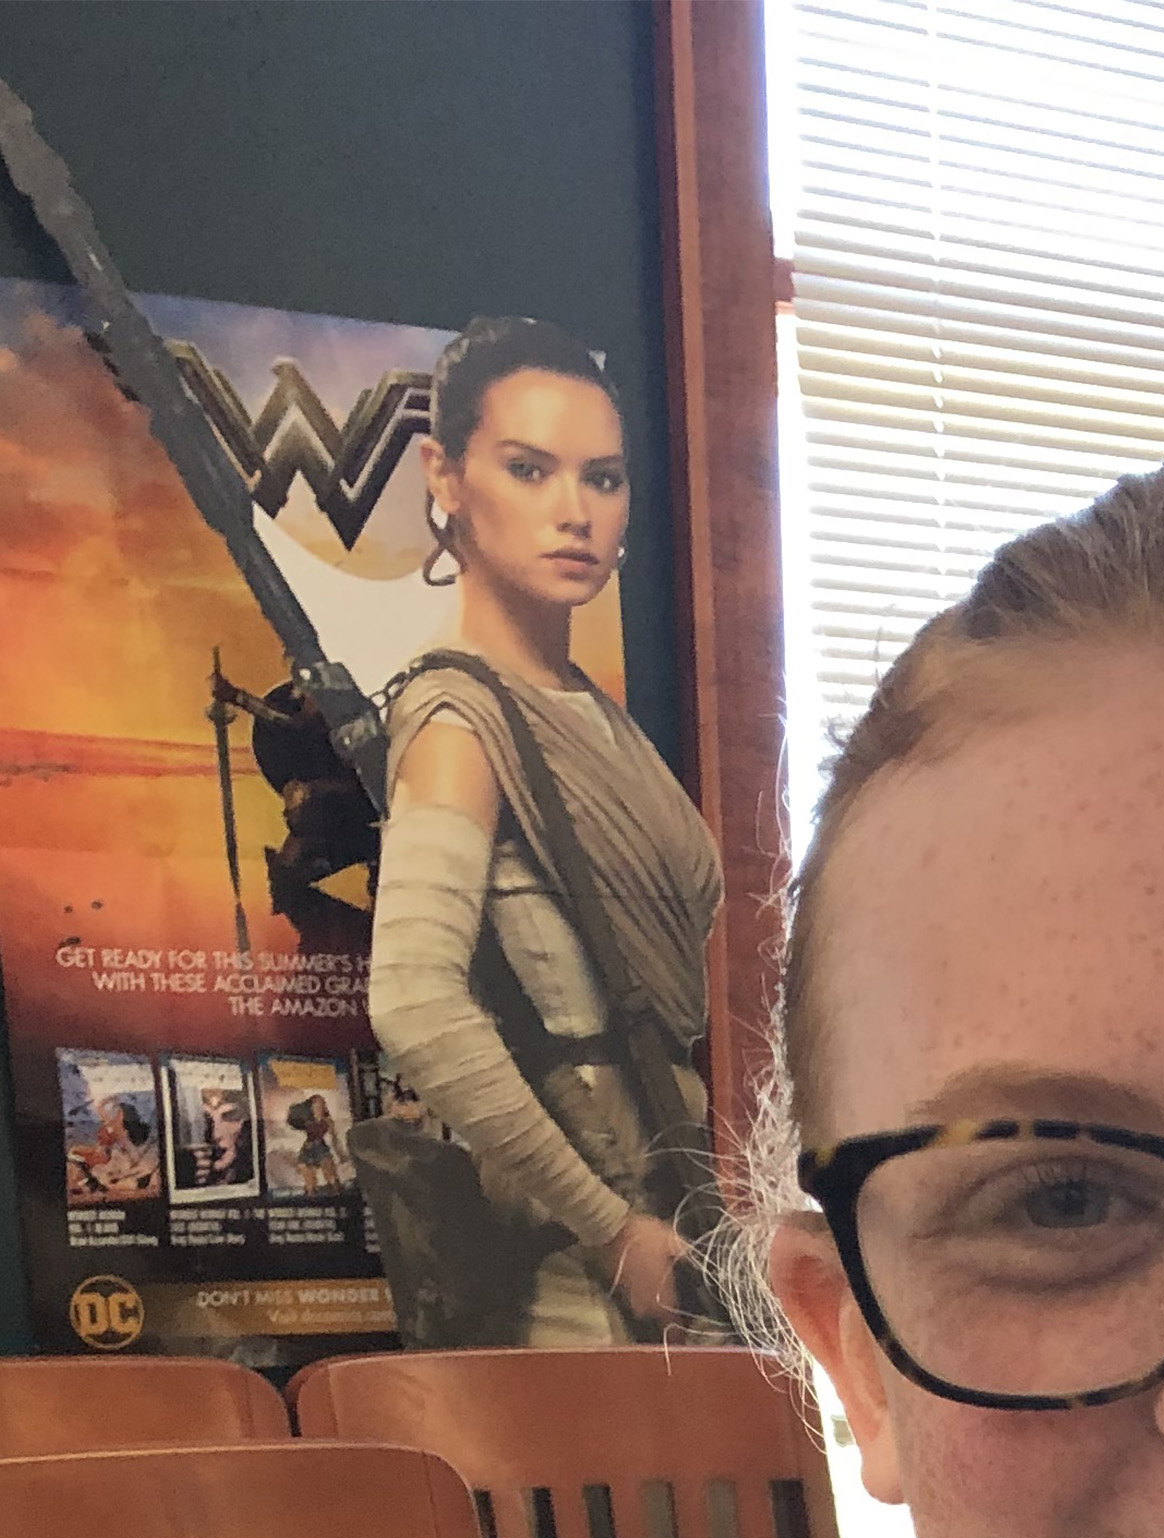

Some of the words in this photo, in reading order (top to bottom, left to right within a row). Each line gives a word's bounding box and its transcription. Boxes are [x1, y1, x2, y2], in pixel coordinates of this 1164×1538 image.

[56, 947, 96, 968] GET
[102, 949, 162, 970] READY
[168, 950, 206, 970] FOR
[213, 951, 253, 971] THIS
[92, 971, 145, 992] WITH
[151, 972, 206, 993] THESE
[214, 974, 320, 995] ACCLAIMED
[325, 976, 369, 994] GRA
[228, 996, 264, 1016] THE
[271, 998, 357, 1018] AMAZON
[75, 1289, 142, 1337] DC
